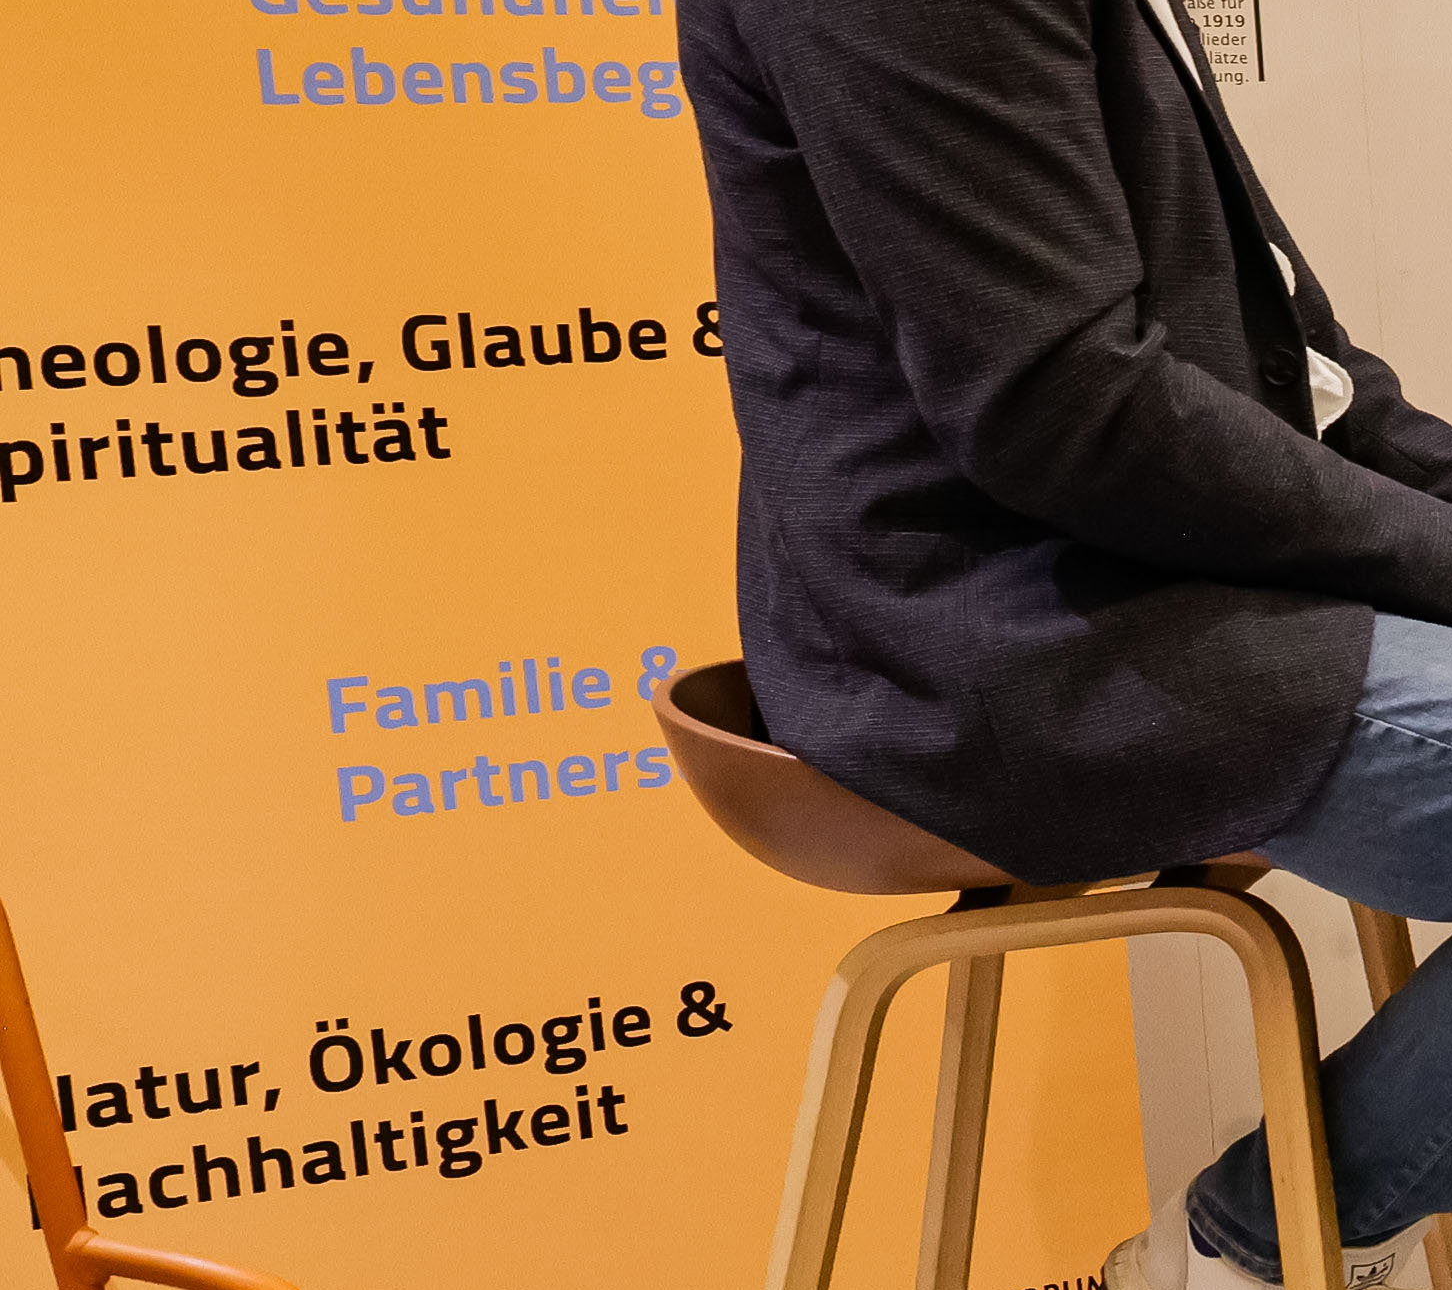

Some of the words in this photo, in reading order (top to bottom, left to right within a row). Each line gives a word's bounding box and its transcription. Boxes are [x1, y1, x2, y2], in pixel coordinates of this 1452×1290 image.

[256, 47, 683, 119] Lebensbeg
[0, 320, 374, 397] eologie,
[401, 307, 667, 372] Glaube
[0, 401, 451, 502] piritualität
[326, 656, 611, 734] Familie
[637, 645, 684, 702] &
[337, 745, 688, 822] Partners
[309, 997, 651, 1093] Ökologie
[677, 981, 733, 1039] &
